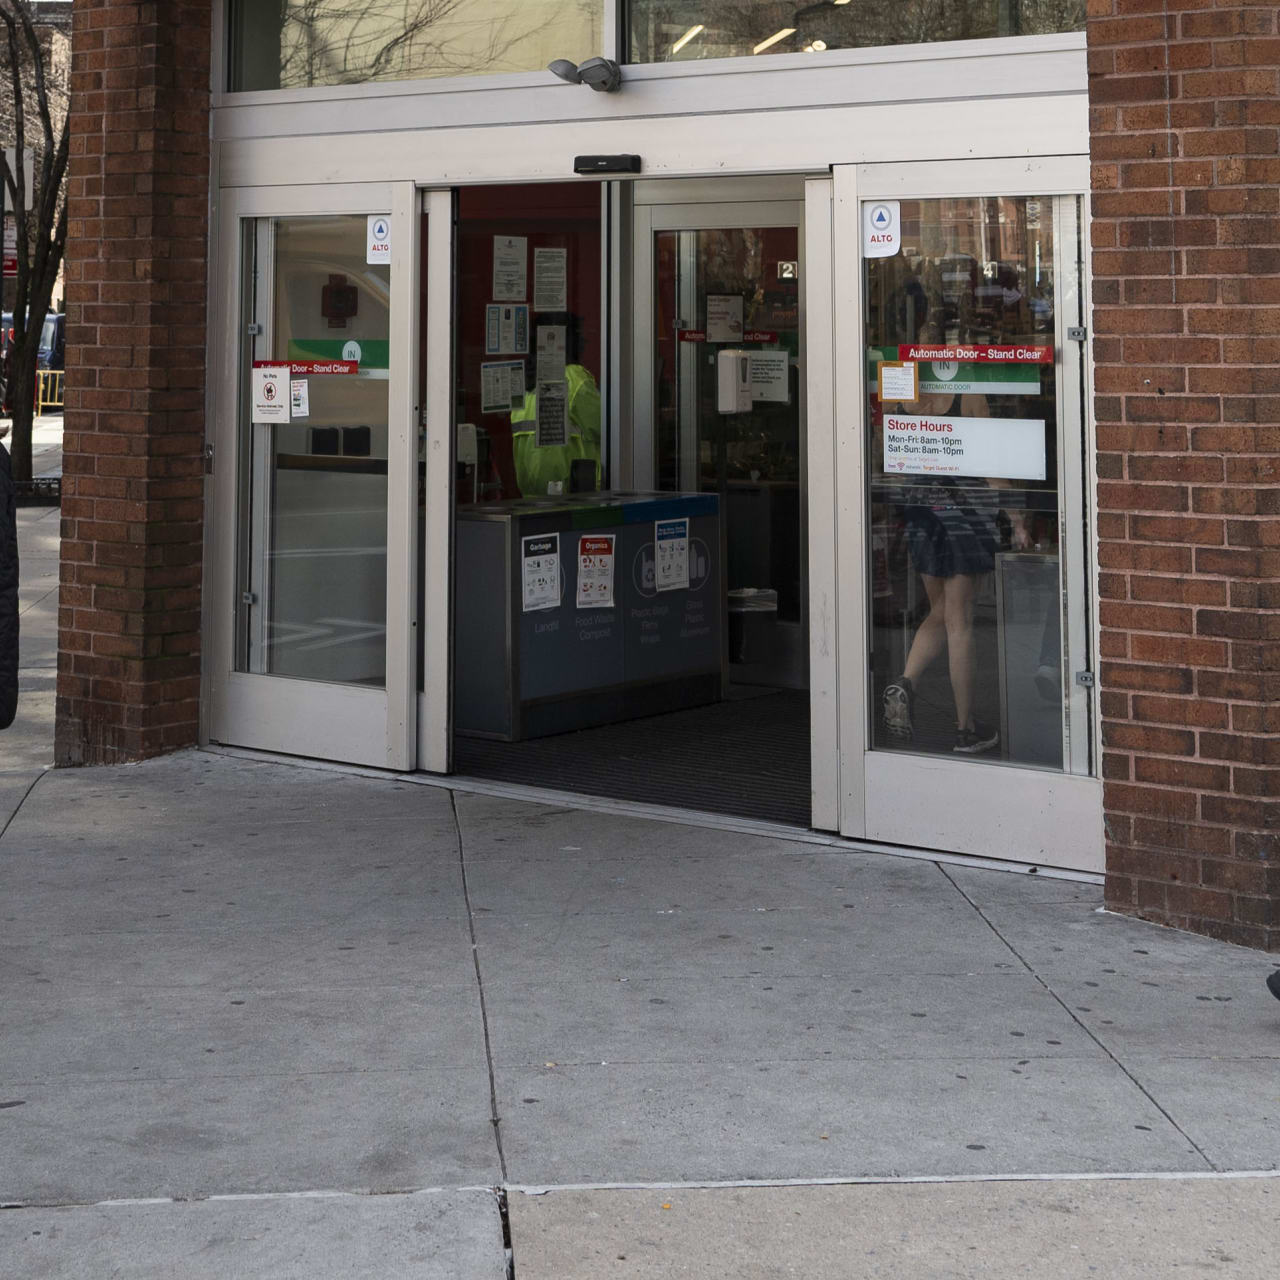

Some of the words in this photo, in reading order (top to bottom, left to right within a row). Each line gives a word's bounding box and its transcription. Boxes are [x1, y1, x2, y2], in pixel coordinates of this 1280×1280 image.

[870, 235, 893, 243] ALTO
[347, 350, 356, 359] IN
[909, 348, 954, 359] Automatic
[956, 348, 979, 359] Door
[988, 349, 1015, 359] Stand
[1016, 349, 1042, 360] Clear
[292, 364, 308, 373] Door
[313, 364, 332, 373] Stand
[332, 365, 350, 373] Clear
[887, 419, 917, 432] Store
[920, 420, 953, 433] Hours
[920, 436, 962, 447] 8am-10pm
[887, 445, 921, 454] Sat-Sun:
[921, 446, 964, 456] 8am-10pm
[585, 541, 609, 551] Organics
